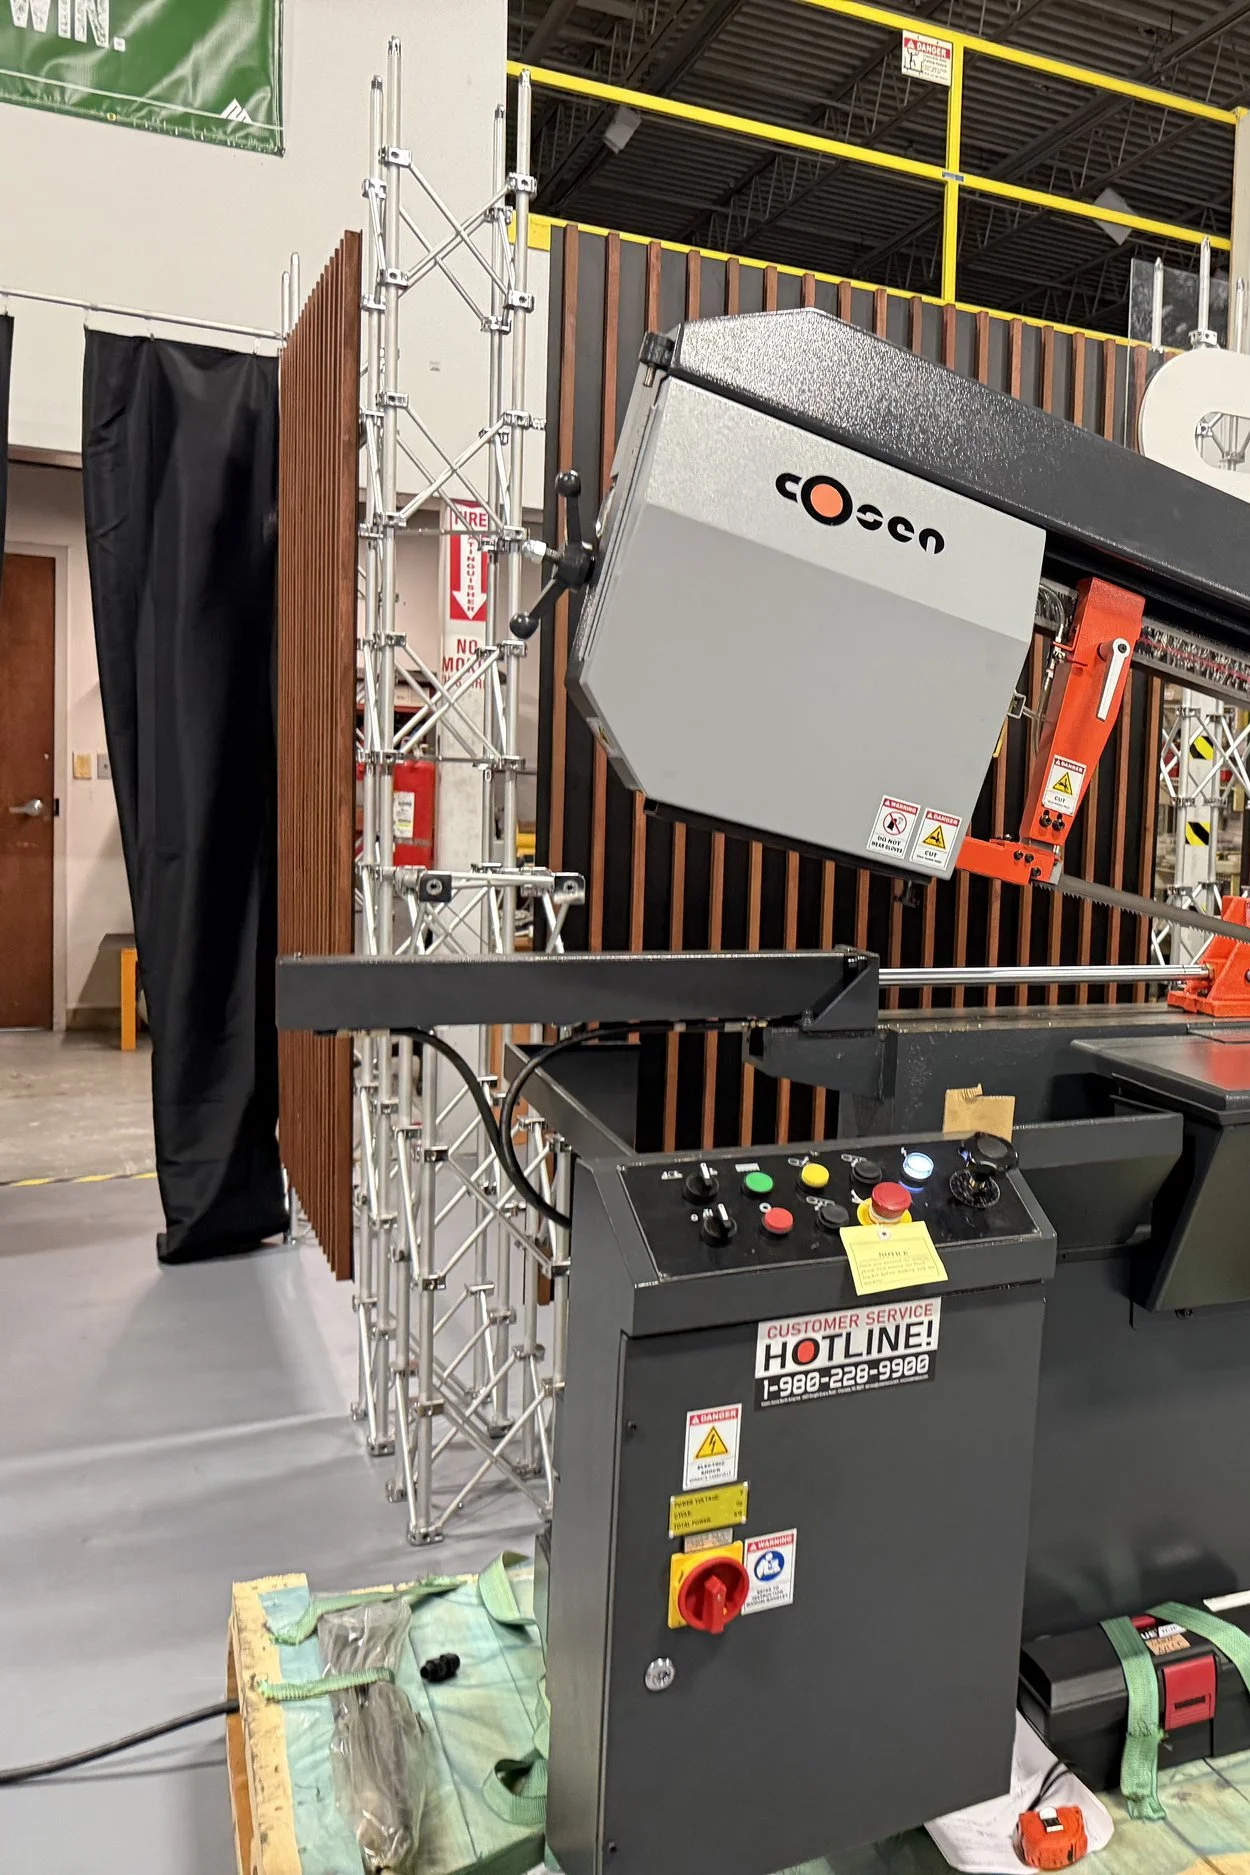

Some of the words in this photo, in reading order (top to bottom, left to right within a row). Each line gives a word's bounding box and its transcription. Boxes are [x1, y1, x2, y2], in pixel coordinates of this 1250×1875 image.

[916, 41, 946, 57] DANGER
[933, 812, 958, 825] DANGER
[924, 849, 938, 858] CUT
[767, 1313, 860, 1340] CUSTOMER
[866, 1303, 933, 1326] SERVICE
[763, 1319, 933, 1372] HOTLINE!
[762, 1353, 930, 1400] 1-980-228-9900
[700, 1409, 736, 1422] DANGER
[758, 1535, 793, 1550] WARNING
